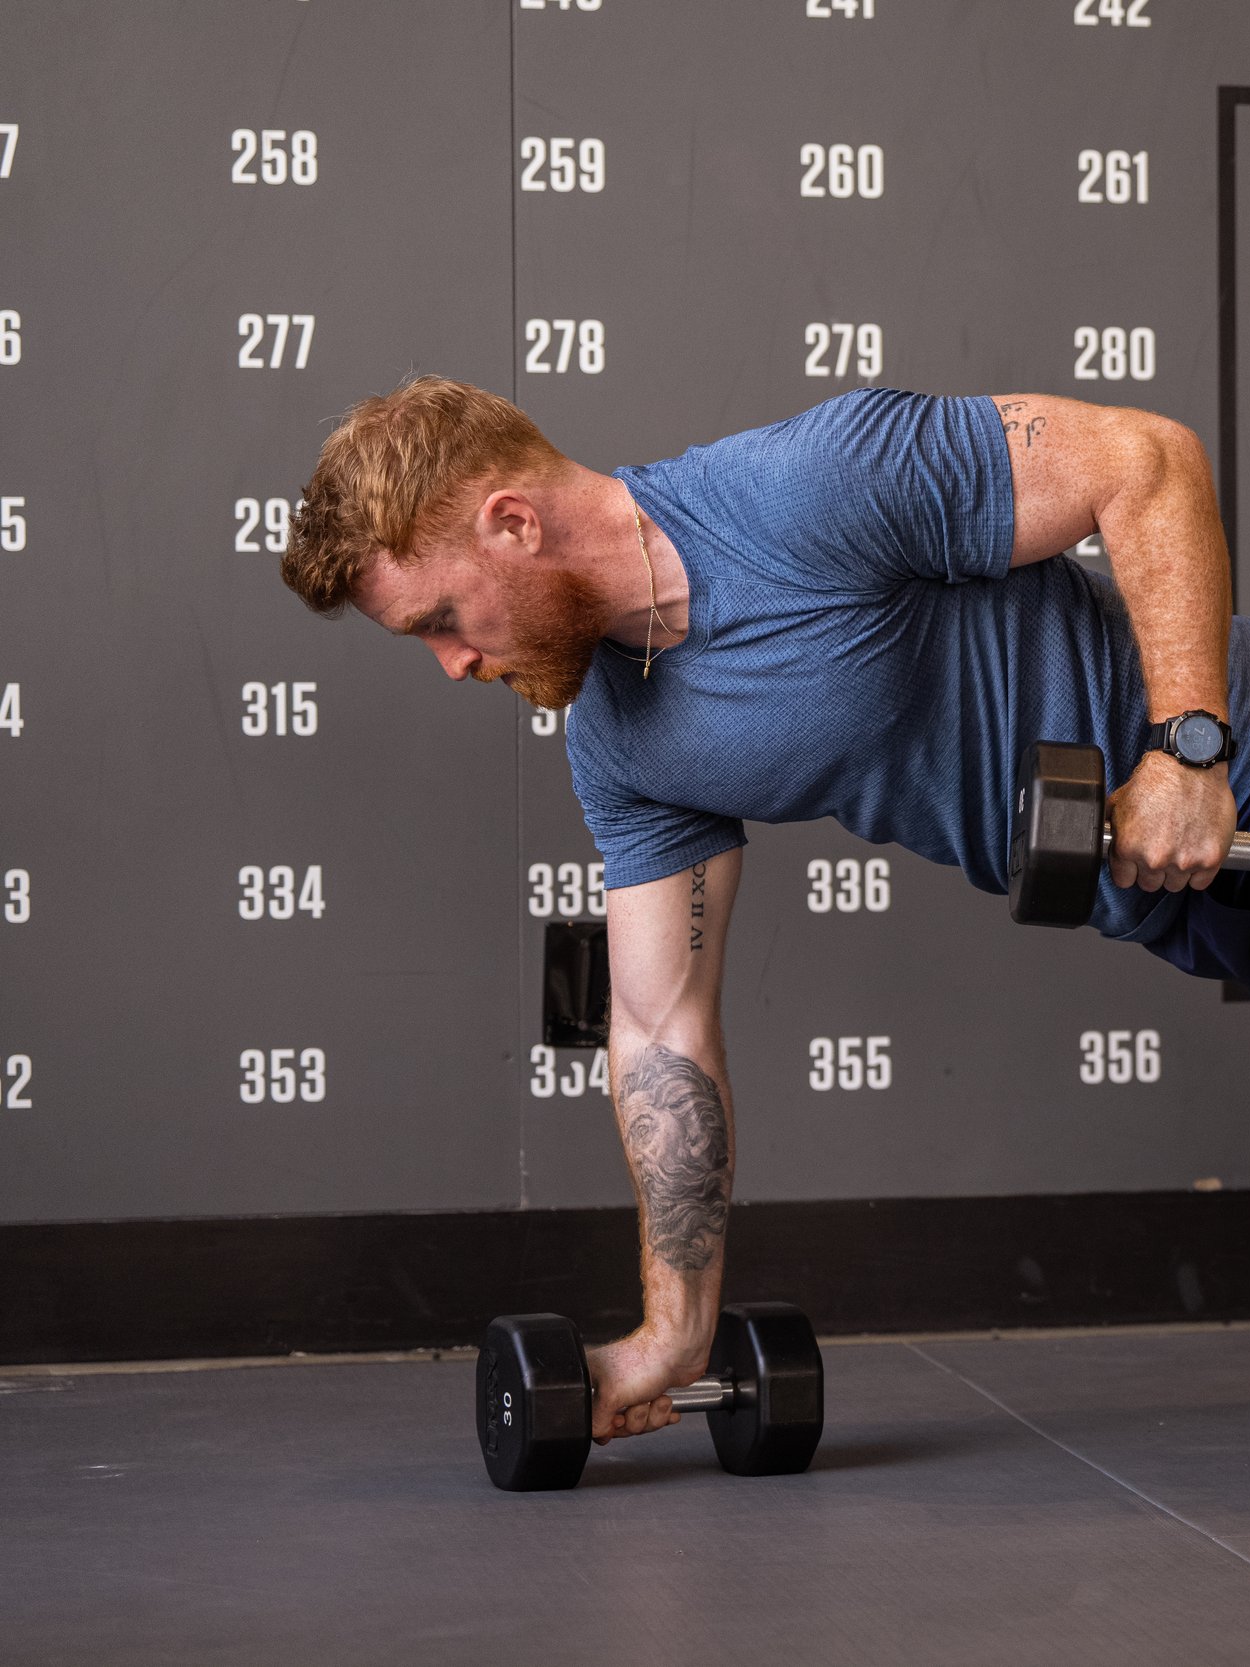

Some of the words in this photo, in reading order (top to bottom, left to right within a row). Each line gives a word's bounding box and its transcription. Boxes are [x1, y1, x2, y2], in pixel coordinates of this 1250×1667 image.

[230, 128, 318, 186] 258
[520, 136, 606, 194] 259
[799, 142, 885, 200] 260
[1077, 148, 1149, 205] 261
[237, 312, 316, 370] 277
[524, 318, 606, 375] 278
[804, 322, 883, 381] 279
[1073, 326, 1156, 381] 280
[234, 497, 308, 553] 29
[241, 681, 318, 737] 315
[238, 864, 326, 921] 334
[527, 862, 607, 917] 335
[691, 901, 704, 918] II
[807, 858, 890, 913] 336
[690, 926, 704, 952] IV
[239, 1047, 326, 1104] 353
[809, 1035, 892, 1092] 355
[1079, 1029, 1160, 1084] 356
[503, 1391, 513, 1427] 30
